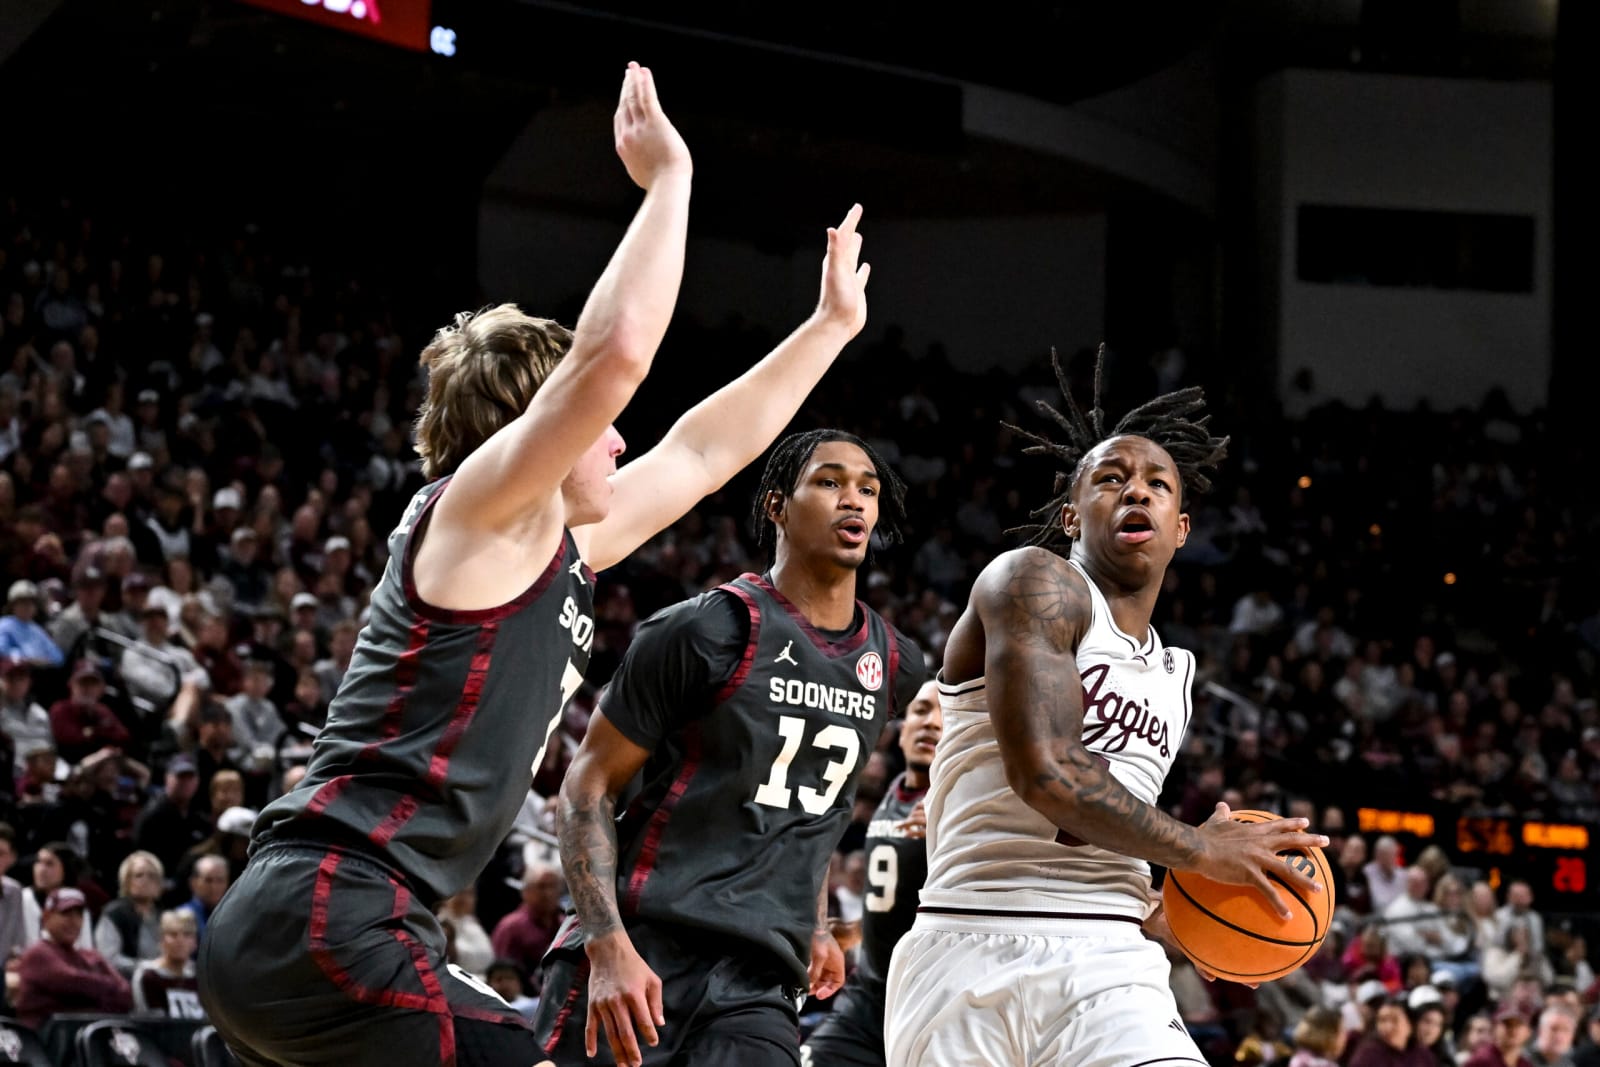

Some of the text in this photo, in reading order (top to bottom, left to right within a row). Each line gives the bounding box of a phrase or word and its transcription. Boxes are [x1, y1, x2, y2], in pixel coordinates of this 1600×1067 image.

[769, 676, 876, 720] SOONERS
[857, 653, 882, 690] SEC
[1080, 663, 1171, 760] Aggies
[754, 715, 860, 816] 13
[865, 845, 898, 912] 9
